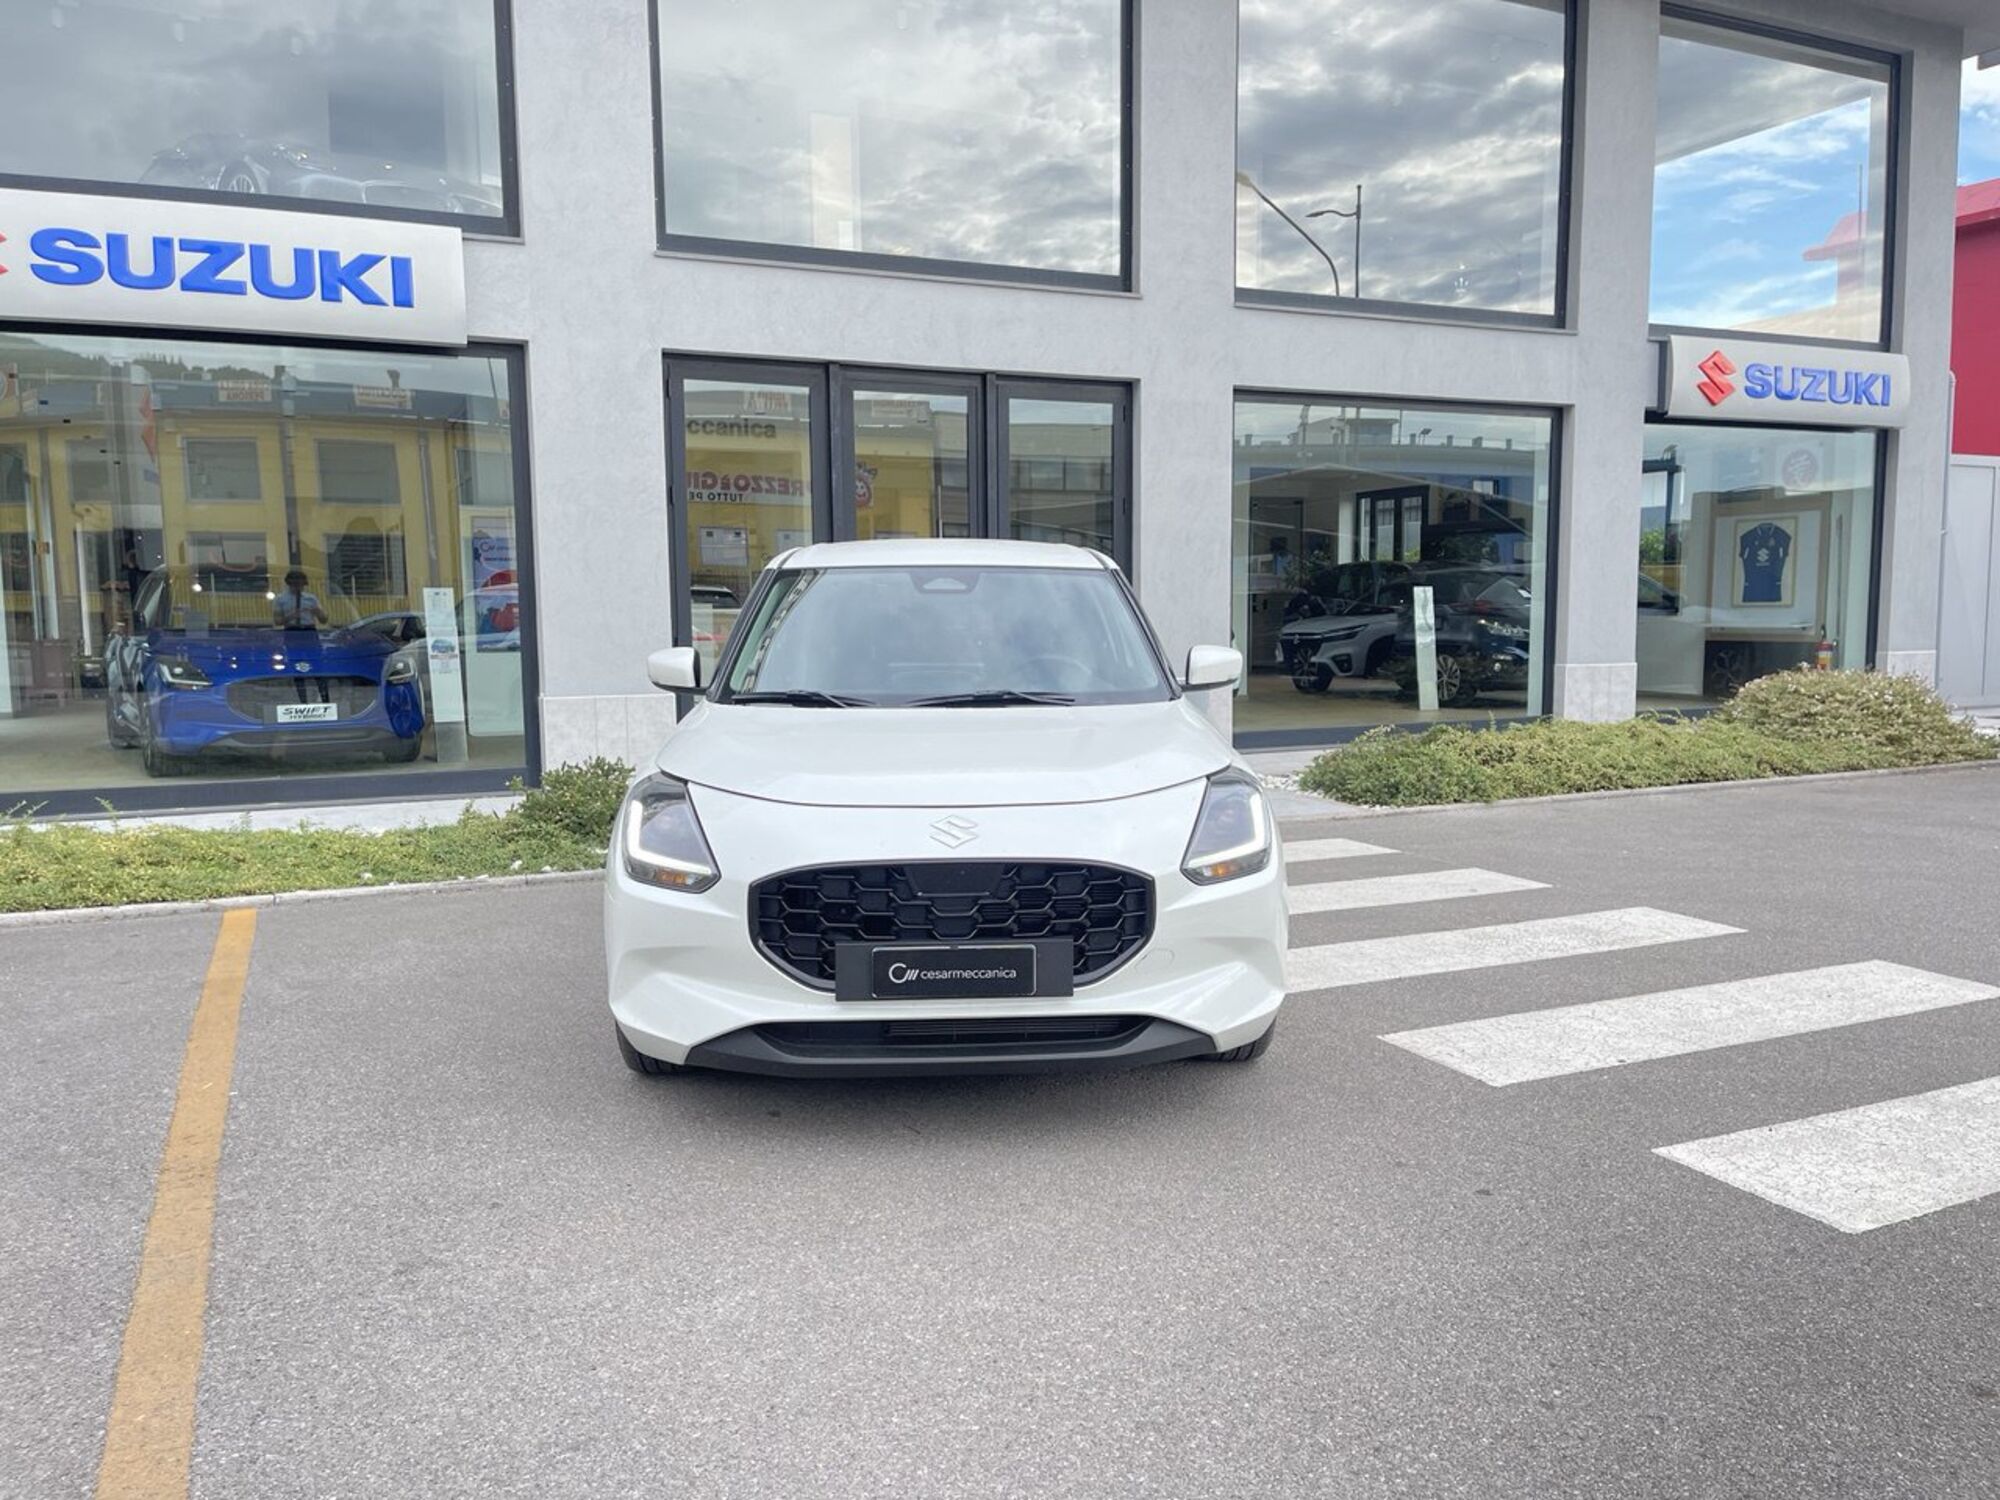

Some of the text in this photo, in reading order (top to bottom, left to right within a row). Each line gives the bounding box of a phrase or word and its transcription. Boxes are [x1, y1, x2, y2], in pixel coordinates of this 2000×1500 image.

[30, 228, 414, 308] SUZUKI
[1744, 363, 1891, 407] SUZUKI
[920, 966, 1017, 980] cesarmeccanica
